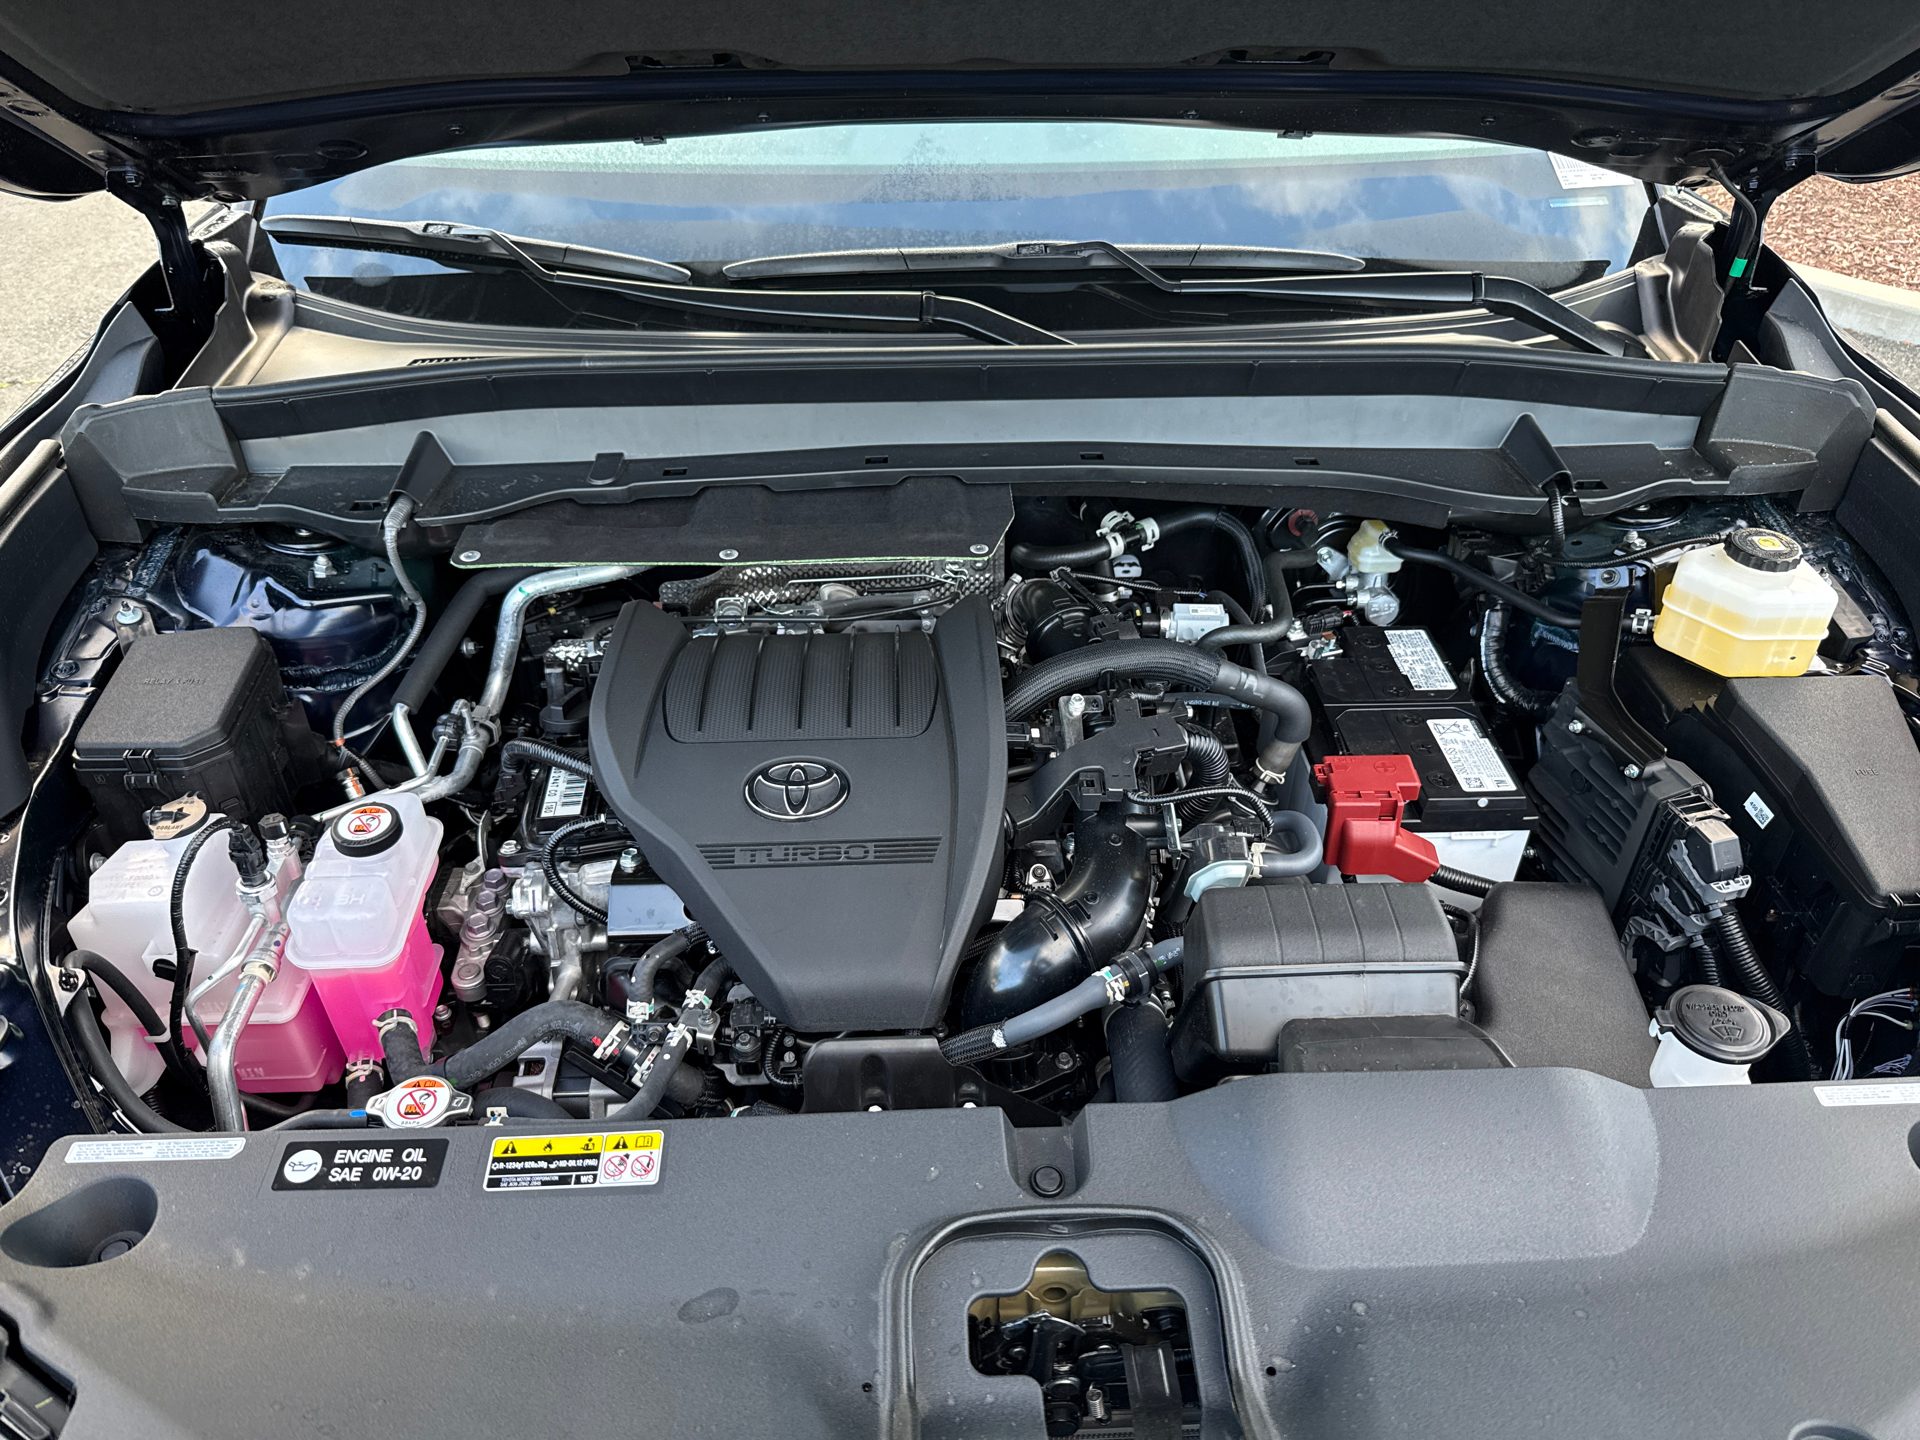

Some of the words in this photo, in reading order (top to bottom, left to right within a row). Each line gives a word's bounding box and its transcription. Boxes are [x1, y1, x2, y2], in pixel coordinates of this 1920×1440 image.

[1855, 768, 1880, 776] FUSE
[739, 844, 870, 862] TURBO
[236, 1067, 264, 1078] MIN
[334, 1149, 394, 1163] ENGINE
[401, 1148, 427, 1162] OIL
[328, 1167, 363, 1182] SAE
[372, 1166, 422, 1181] 0W-20
[580, 1174, 594, 1183] WS
